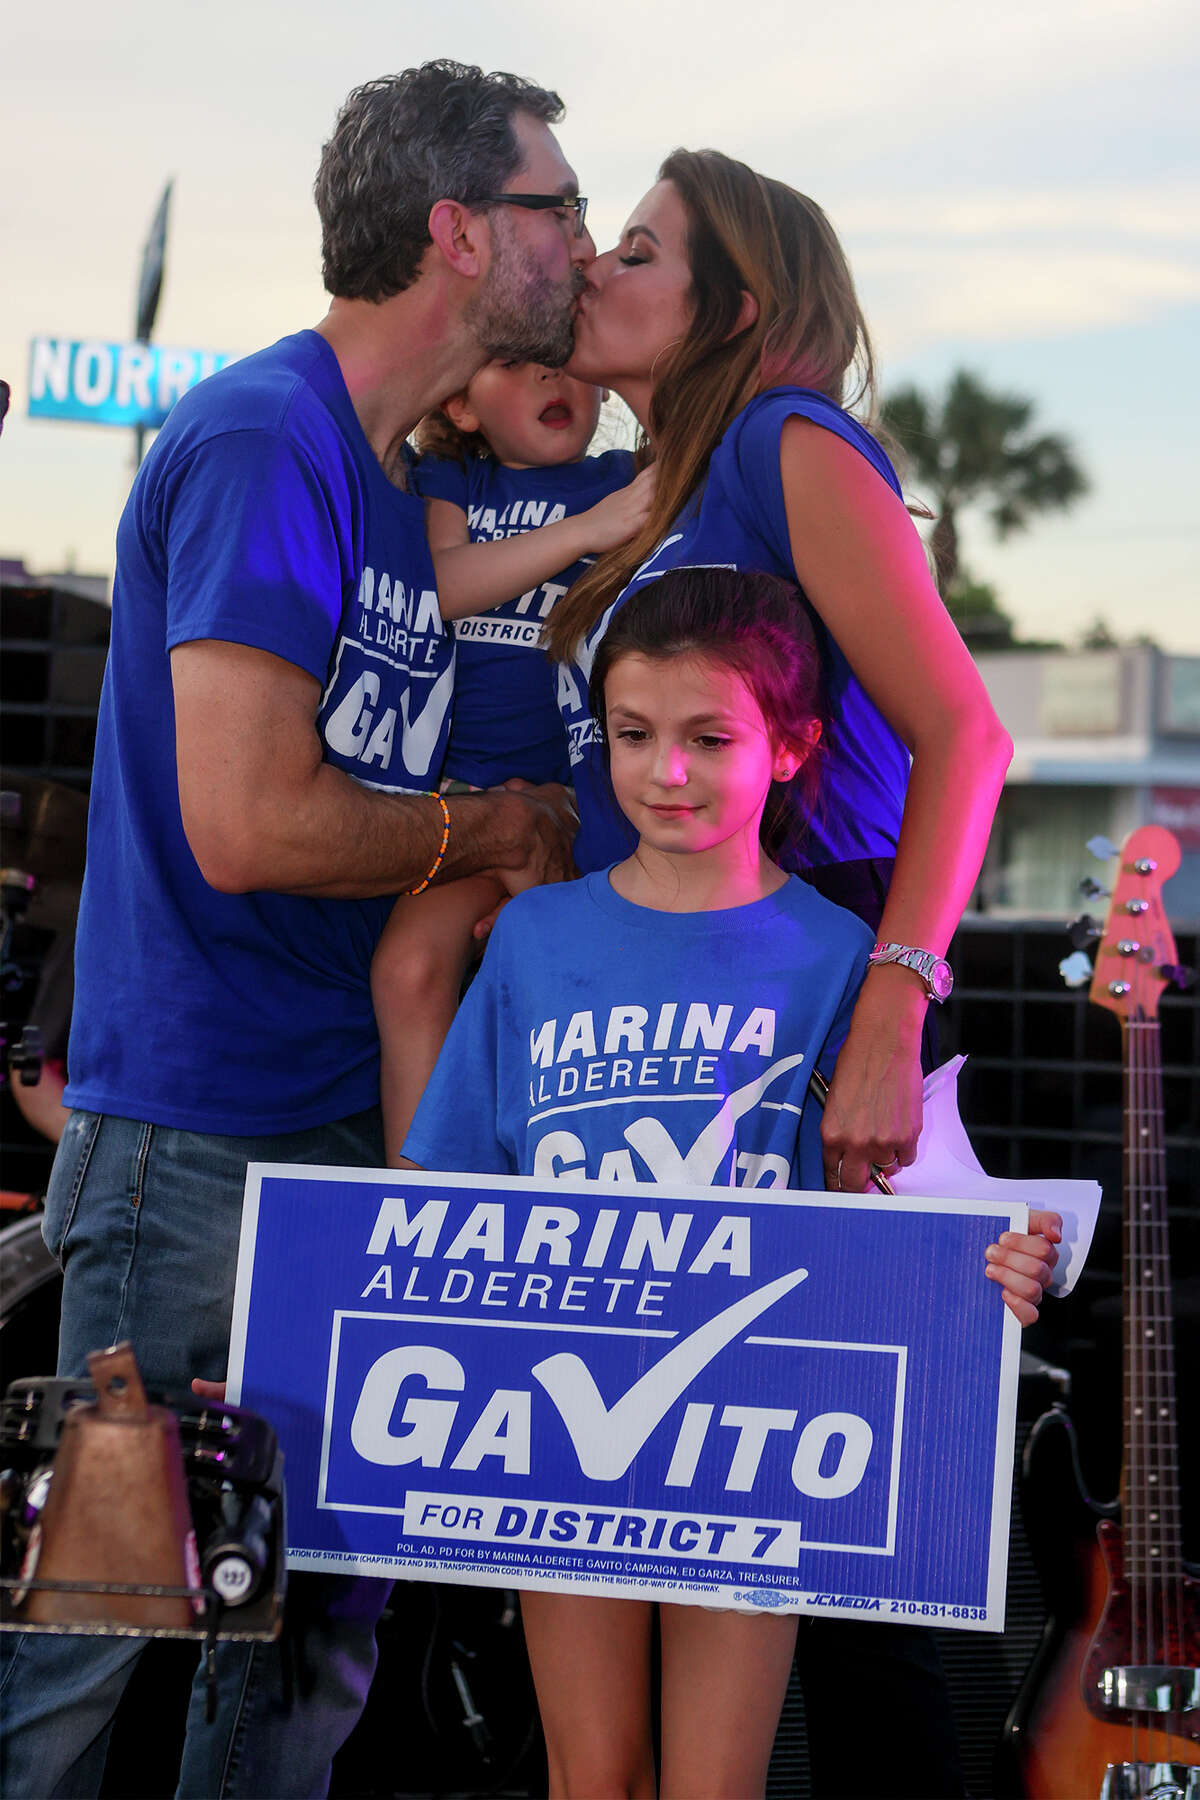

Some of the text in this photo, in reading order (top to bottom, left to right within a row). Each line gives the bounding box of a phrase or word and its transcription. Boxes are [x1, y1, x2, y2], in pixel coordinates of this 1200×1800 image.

[32, 337, 218, 409] NORR
[467, 501, 566, 533] MAINA
[460, 620, 545, 642] DISTRIC
[530, 1003, 775, 1069] MARINA
[366, 1198, 751, 1277] MARINA
[360, 1265, 672, 1316] ALDERETE
[350, 1268, 873, 1499] GAVITO
[420, 1504, 782, 1558] FOR DISTRICT 7
[287, 1549, 311, 1559] LATION
[312, 1550, 321, 1559] OF
[323, 1551, 343, 1561] STATE
[344, 1552, 359, 1562] LAW
[359, 1553, 393, 1565] (CHAPTER
[407, 1558, 423, 1568] AND
[440, 1561, 500, 1574] TRANSPORTATION
[501, 1566, 522, 1577] CODE)
[524, 1568, 533, 1577] TO
[534, 1569, 556, 1579] PLACE
[557, 1571, 573, 1580] THIS
[574, 1572, 591, 1582] SIGN
[592, 1573, 600, 1583] IN
[600, 1574, 614, 1584] THE
[615, 1576, 666, 1589] RIGHT-OF-WAY
[667, 1580, 677, 1589] OF
[678, 1581, 684, 1590] A
[685, 1582, 720, 1593] HIGHWAY.
[396, 1543, 802, 1587] POL. AD. PD FOR BY MARINA ALDERETE GAVITO CAMPAIGN, ED GARZA, TREASURER.
[890, 1601, 987, 1621] 210-831-6838
